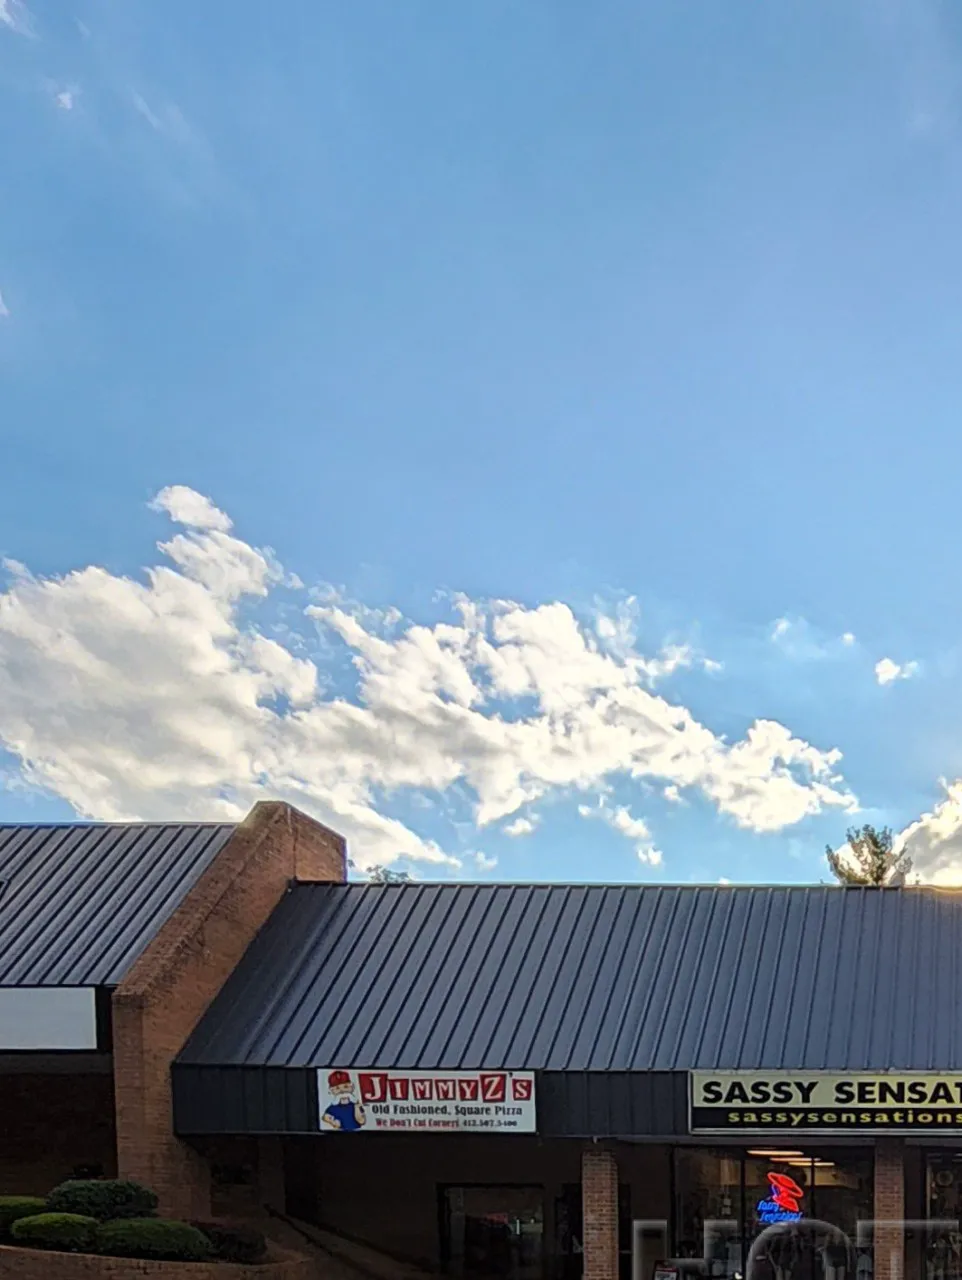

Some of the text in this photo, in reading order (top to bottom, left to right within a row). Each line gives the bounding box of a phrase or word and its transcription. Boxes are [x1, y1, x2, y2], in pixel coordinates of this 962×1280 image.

[702, 1080, 819, 1104] SASSY
[371, 1104, 390, 1115] Old
[454, 1104, 491, 1117] Square
[495, 1105, 523, 1116] Pizza
